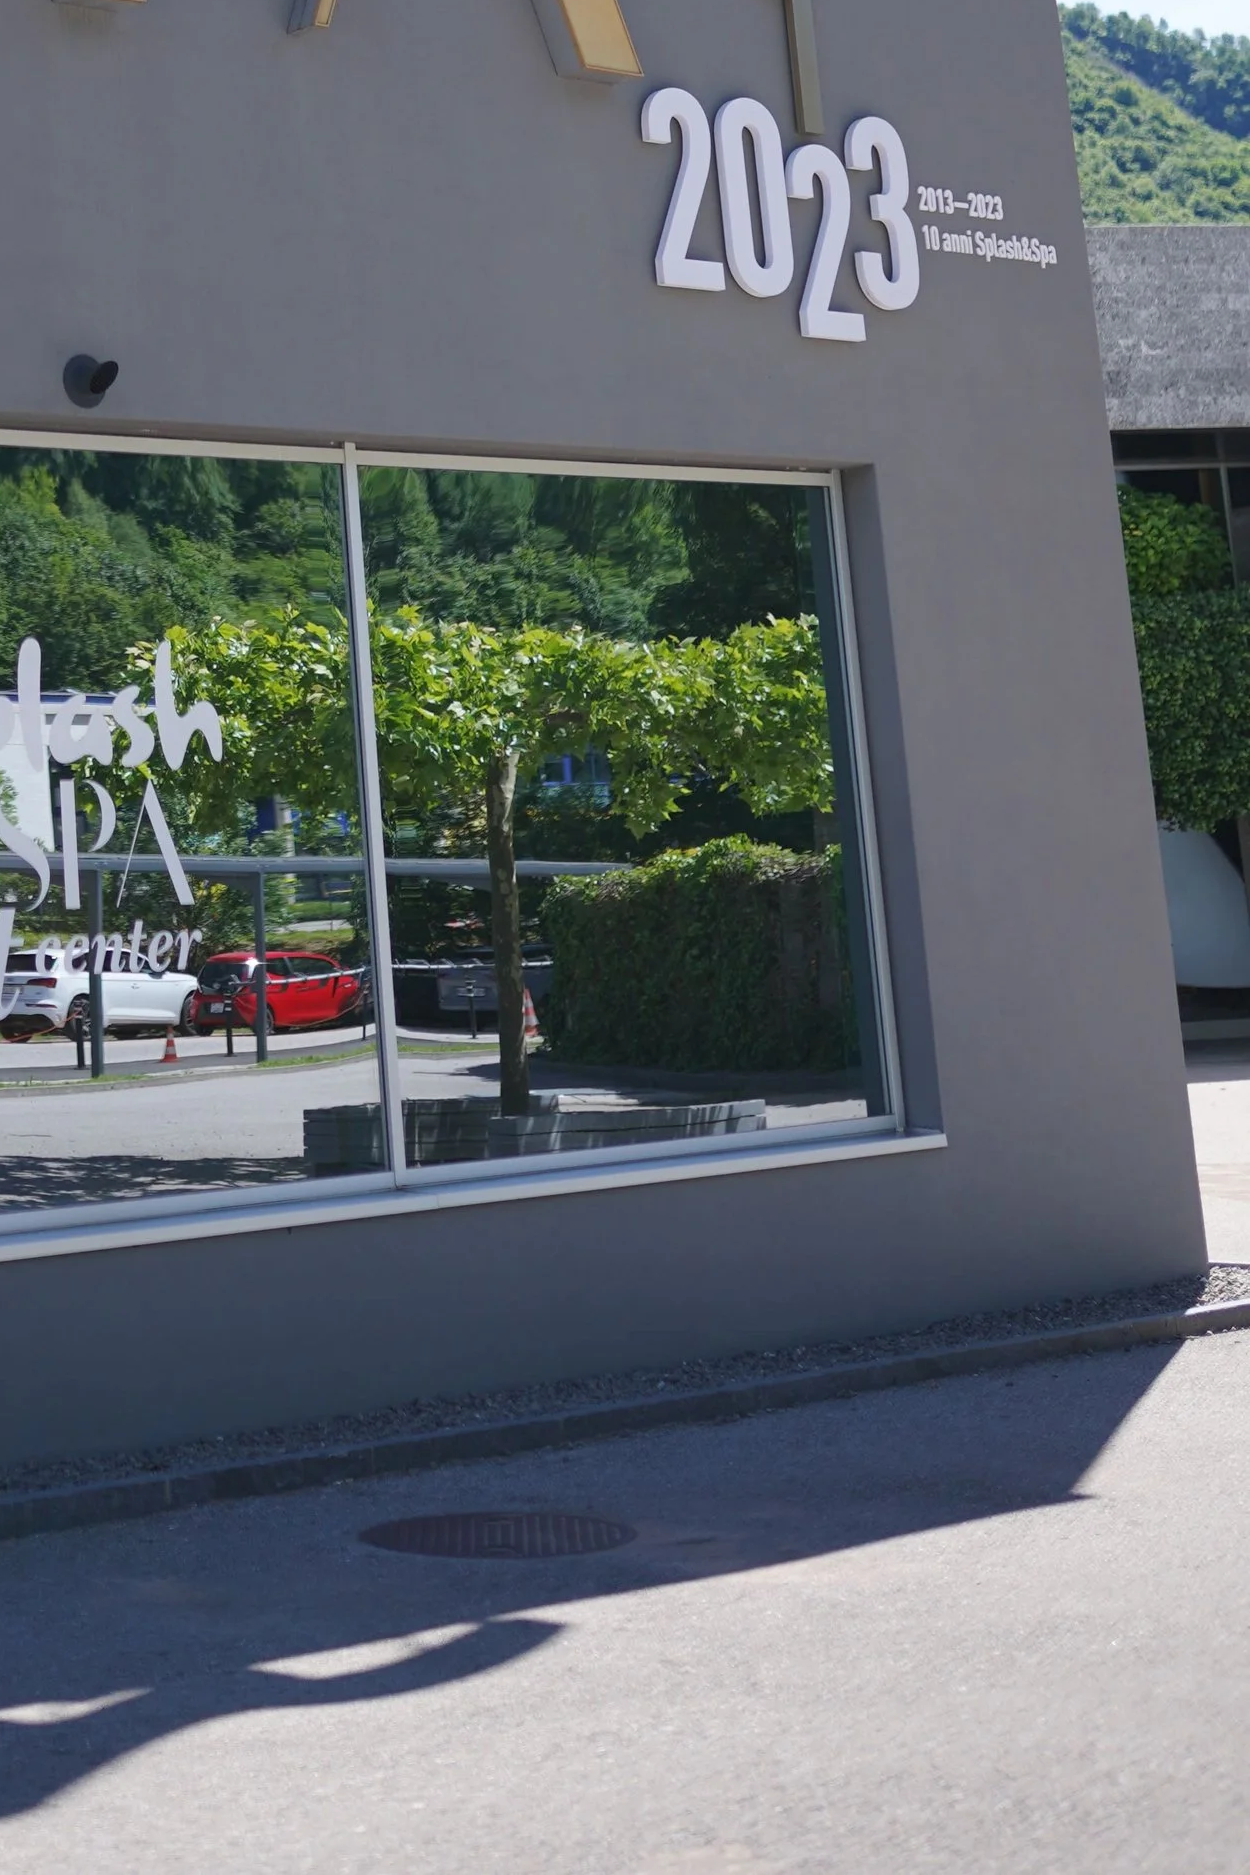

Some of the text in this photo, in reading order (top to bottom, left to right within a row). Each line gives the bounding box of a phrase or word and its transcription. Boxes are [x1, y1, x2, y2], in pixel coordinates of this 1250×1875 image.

[641, 87, 920, 342] 2023
[922, 225, 1058, 269] 10 anni Splash&Spa
[36, 920, 202, 975] center
